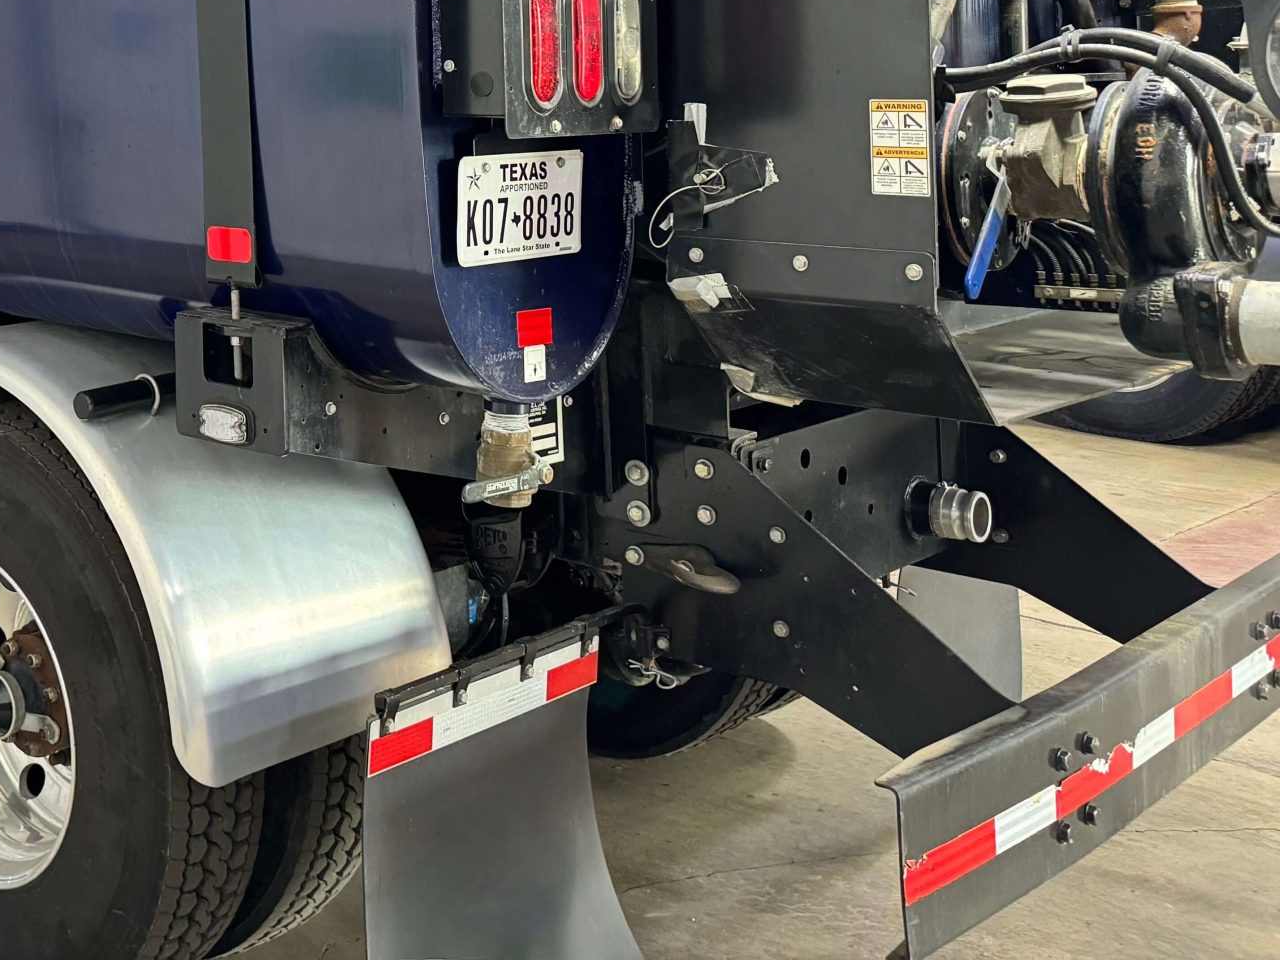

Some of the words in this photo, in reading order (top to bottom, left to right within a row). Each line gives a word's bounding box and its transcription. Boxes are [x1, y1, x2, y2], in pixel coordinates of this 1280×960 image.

[500, 161, 548, 182] TEXAS
[500, 182, 549, 193] APPORTIONED
[522, 192, 575, 241] 8838
[506, 246, 521, 254] Lone
[522, 244, 534, 252] Star
[535, 242, 551, 250] State
